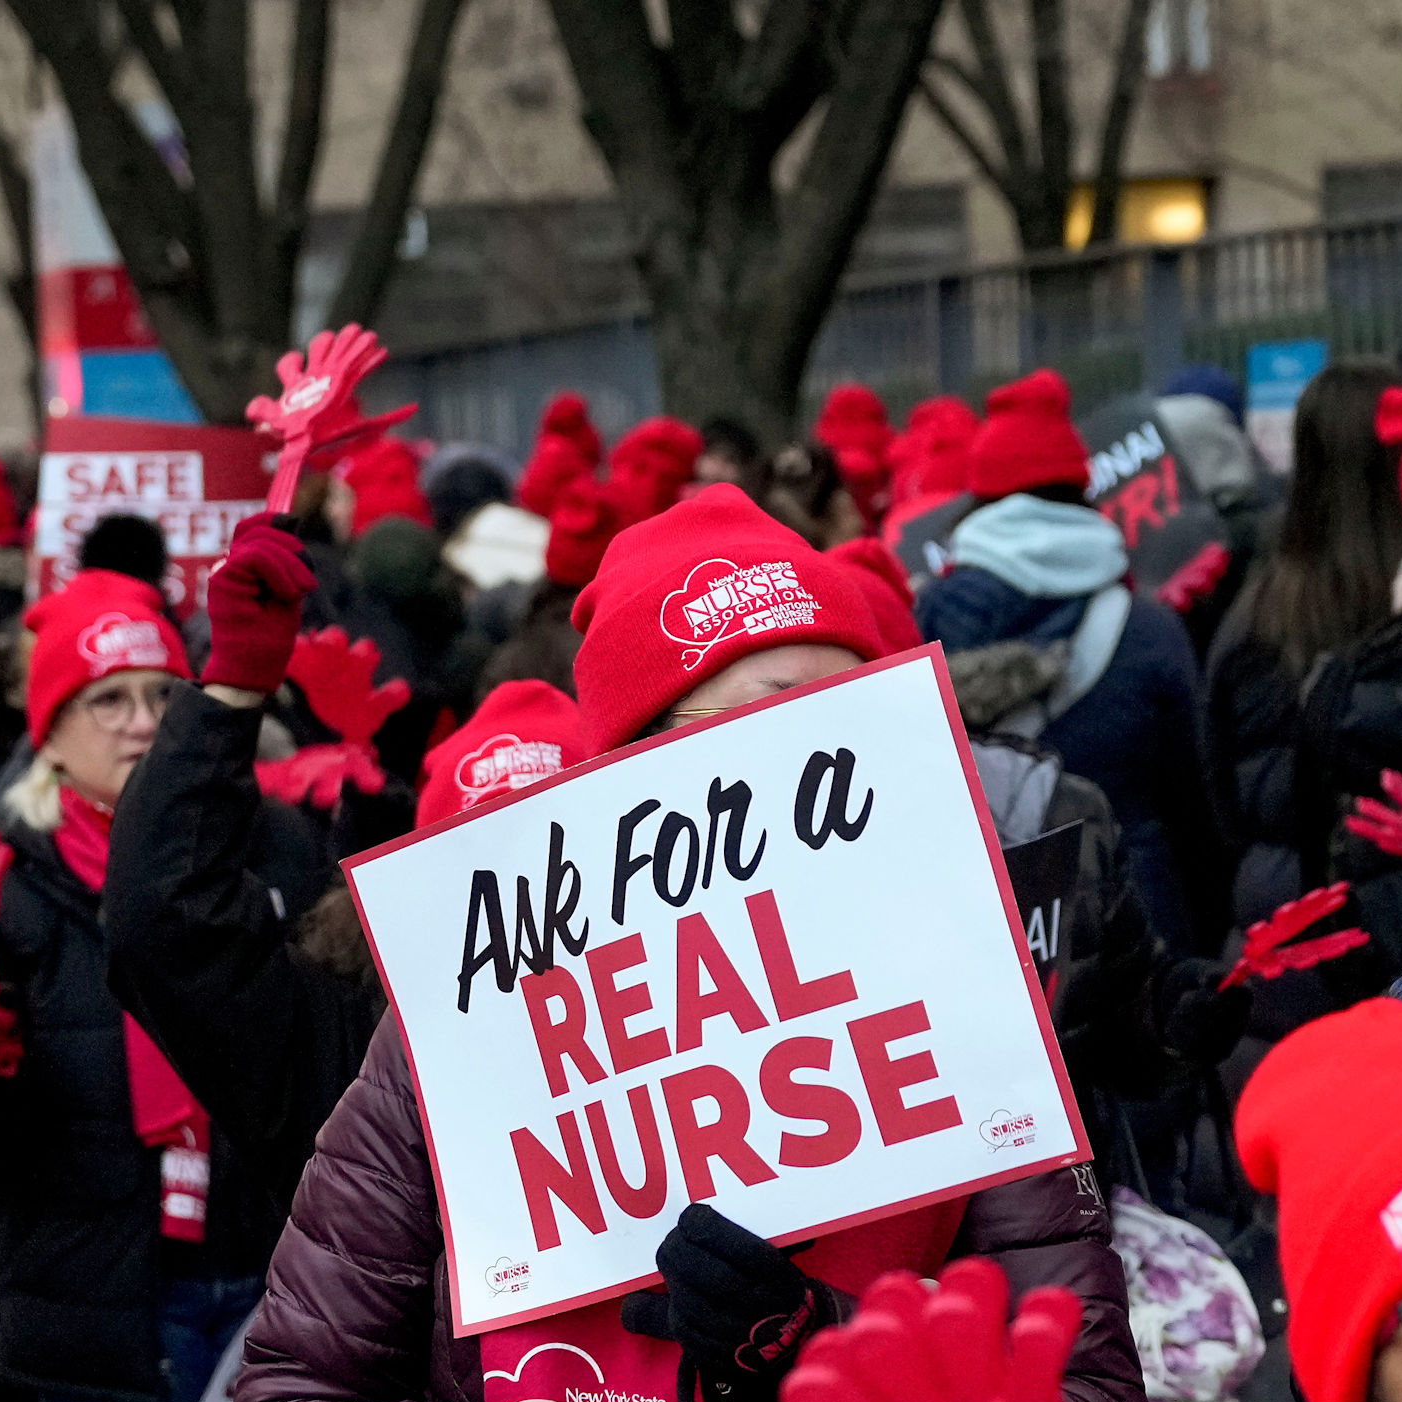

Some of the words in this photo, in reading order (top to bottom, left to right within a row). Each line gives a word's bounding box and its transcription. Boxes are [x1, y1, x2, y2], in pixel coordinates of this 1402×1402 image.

[67, 459, 188, 498] SAFE
[682, 570, 799, 628] NURSES
[708, 573, 736, 590] New
[734, 565, 762, 578] York
[761, 561, 792, 572] State
[457, 822, 589, 1013] Ask
[794, 747, 874, 850] a
[519, 889, 859, 1098] REAL
[509, 999, 963, 1252] NURSE
